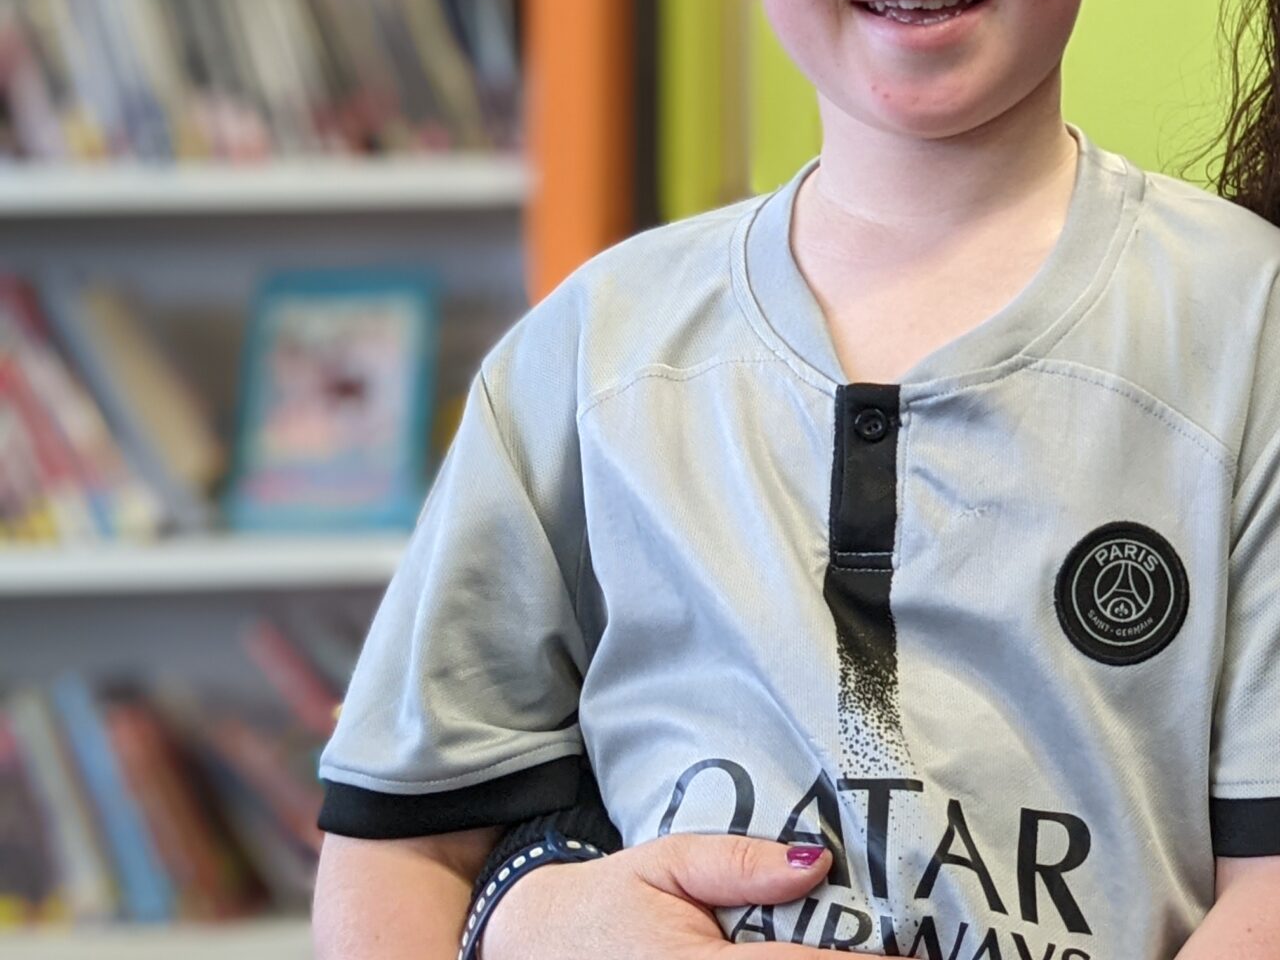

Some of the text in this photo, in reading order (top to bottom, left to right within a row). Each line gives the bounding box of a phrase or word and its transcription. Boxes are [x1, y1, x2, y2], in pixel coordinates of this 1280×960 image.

[1095, 543, 1159, 572] PARIS
[657, 757, 1093, 935] QATAR
[730, 897, 1093, 960] AIRWAY
